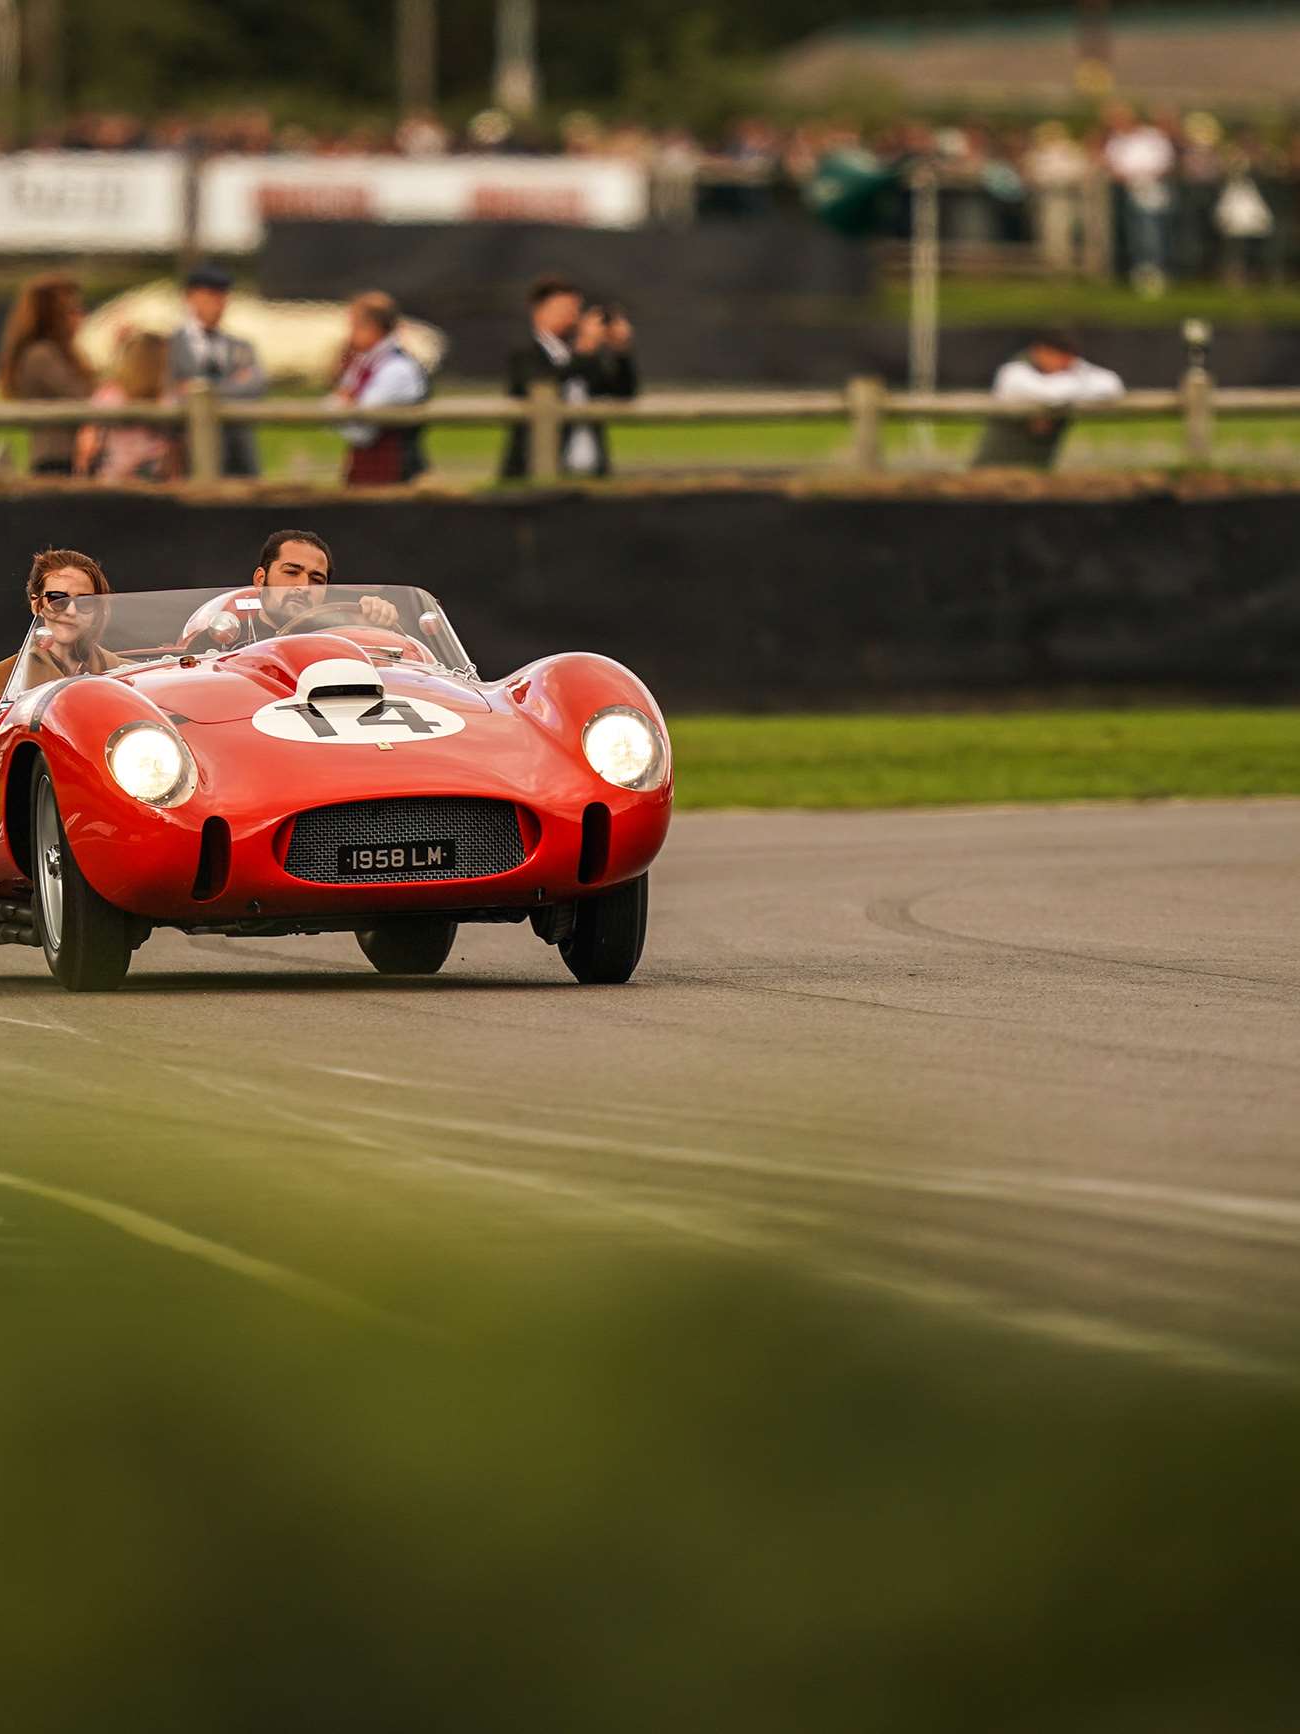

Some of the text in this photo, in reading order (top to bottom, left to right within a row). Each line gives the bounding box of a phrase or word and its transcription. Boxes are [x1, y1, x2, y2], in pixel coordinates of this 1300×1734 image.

[274, 700, 442, 738] 14
[352, 846, 442, 870] 1958 LM
